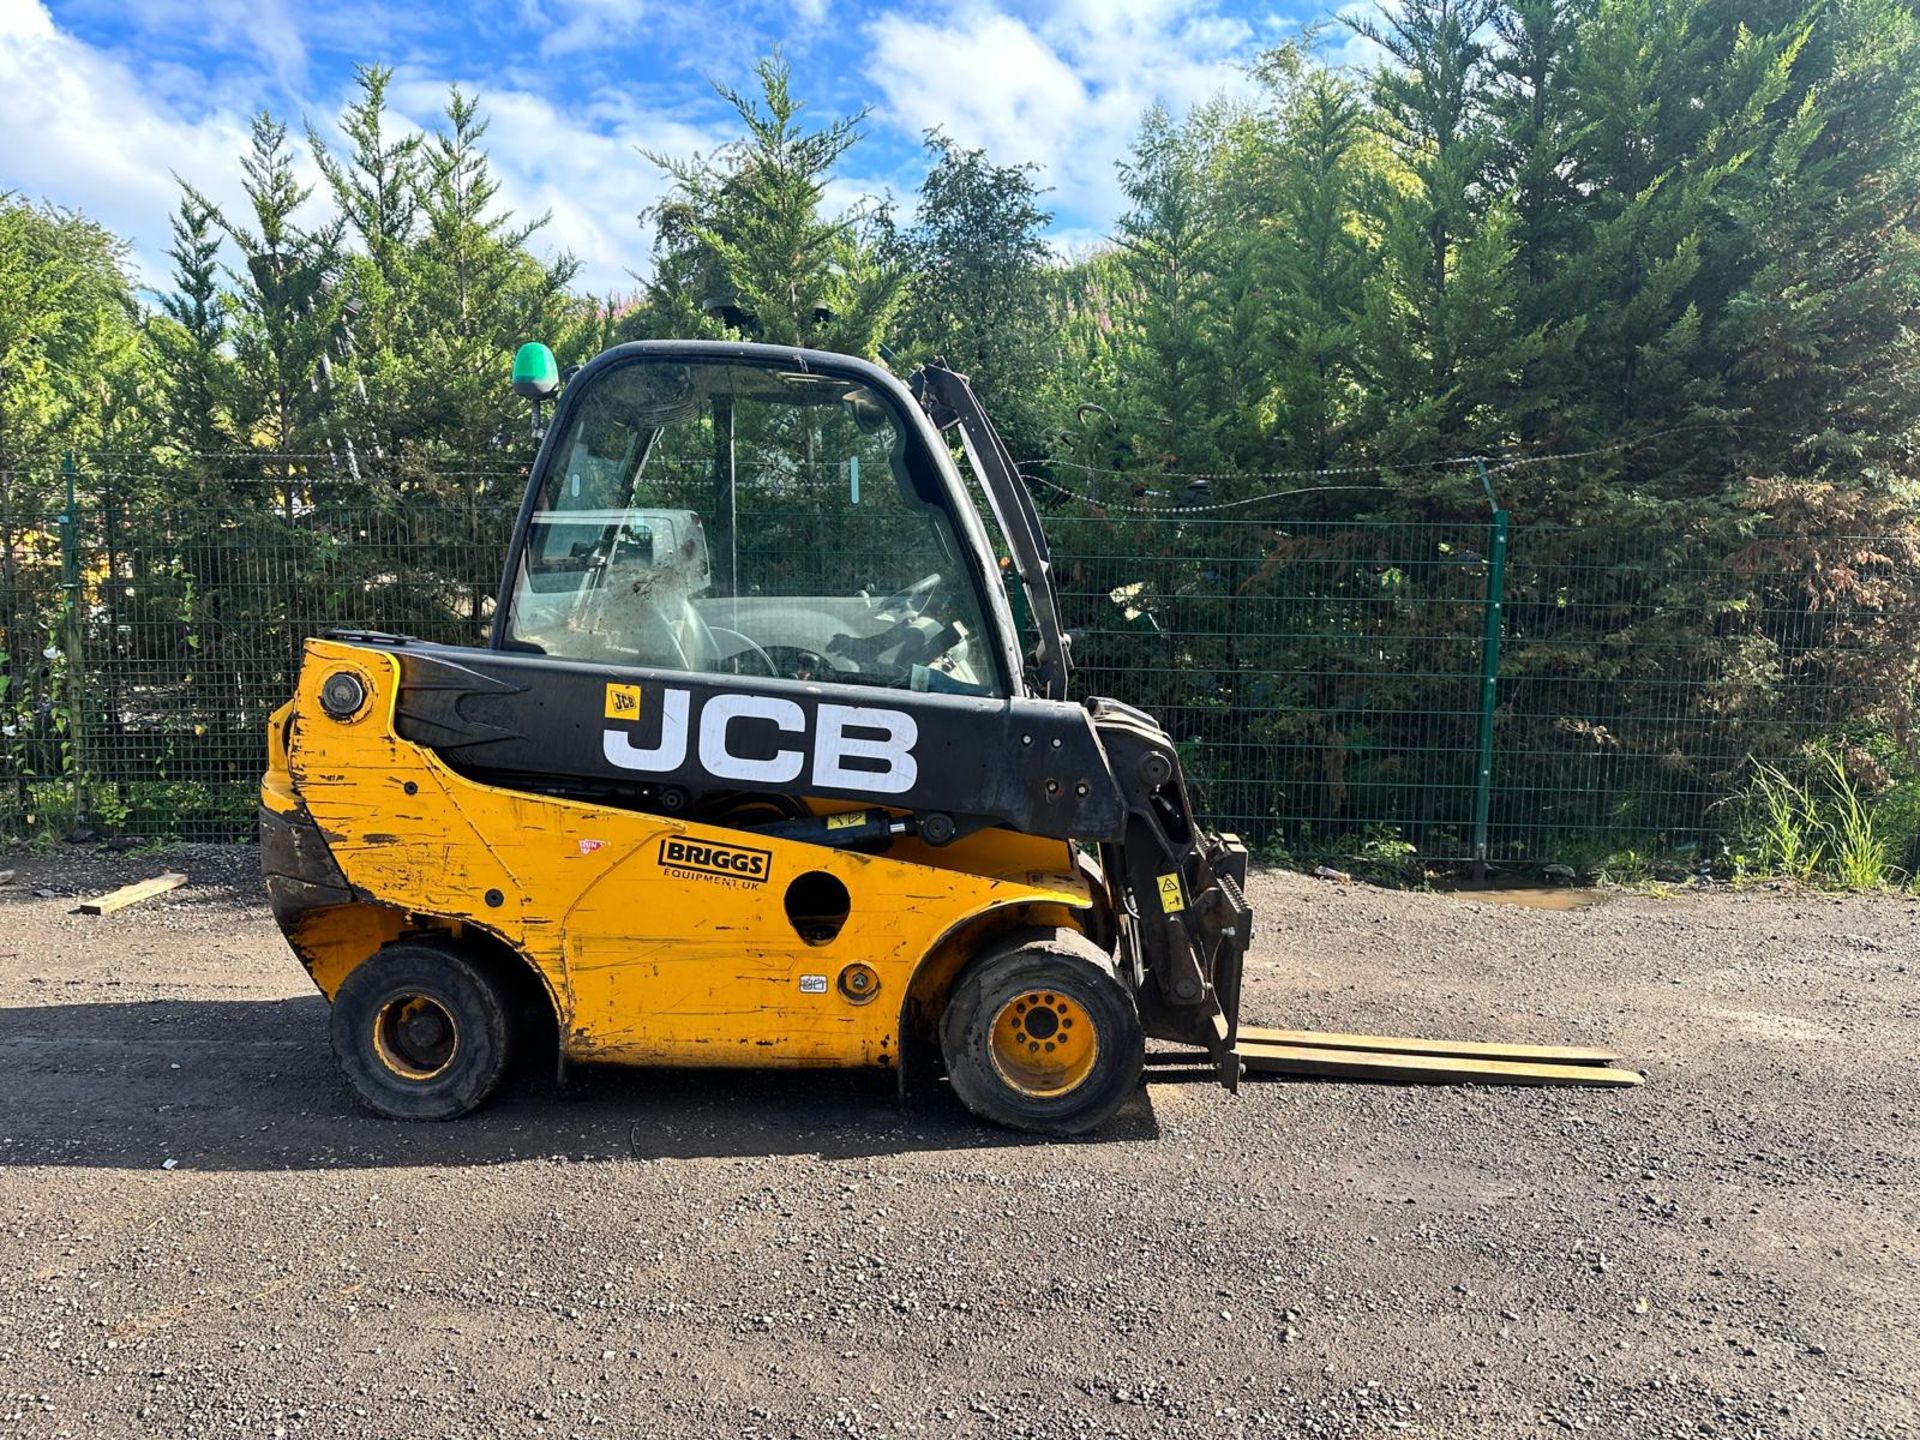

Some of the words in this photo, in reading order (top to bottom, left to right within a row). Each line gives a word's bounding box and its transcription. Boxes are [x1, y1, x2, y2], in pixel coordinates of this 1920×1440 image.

[615, 693, 635, 710] JCB
[603, 689, 918, 793] JCB
[668, 842, 762, 874] BRIGGS
[664, 868, 737, 887] EQUIPMENT
[742, 881, 759, 890] UK
